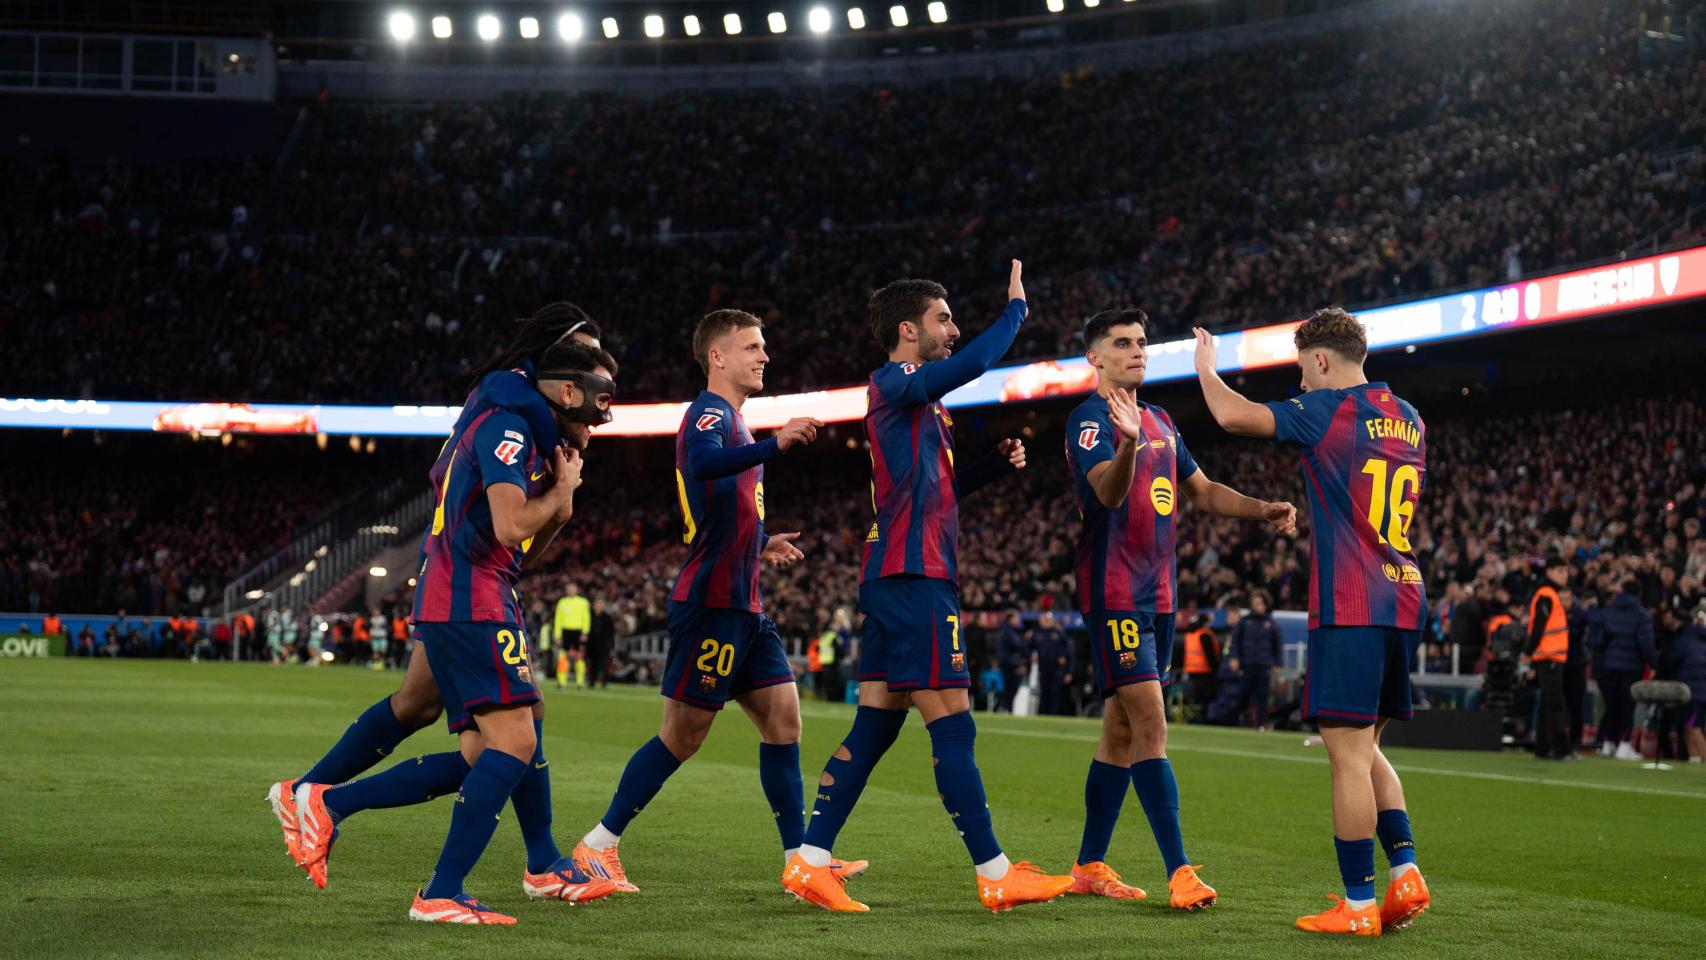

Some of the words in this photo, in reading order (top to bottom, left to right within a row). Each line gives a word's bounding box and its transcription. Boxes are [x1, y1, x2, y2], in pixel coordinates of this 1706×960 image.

[1365, 418, 1421, 449] FERMÍN
[1361, 458, 1419, 552] 16
[946, 615, 960, 651] 7
[1106, 618, 1140, 651] 18
[696, 638, 735, 677] 20
